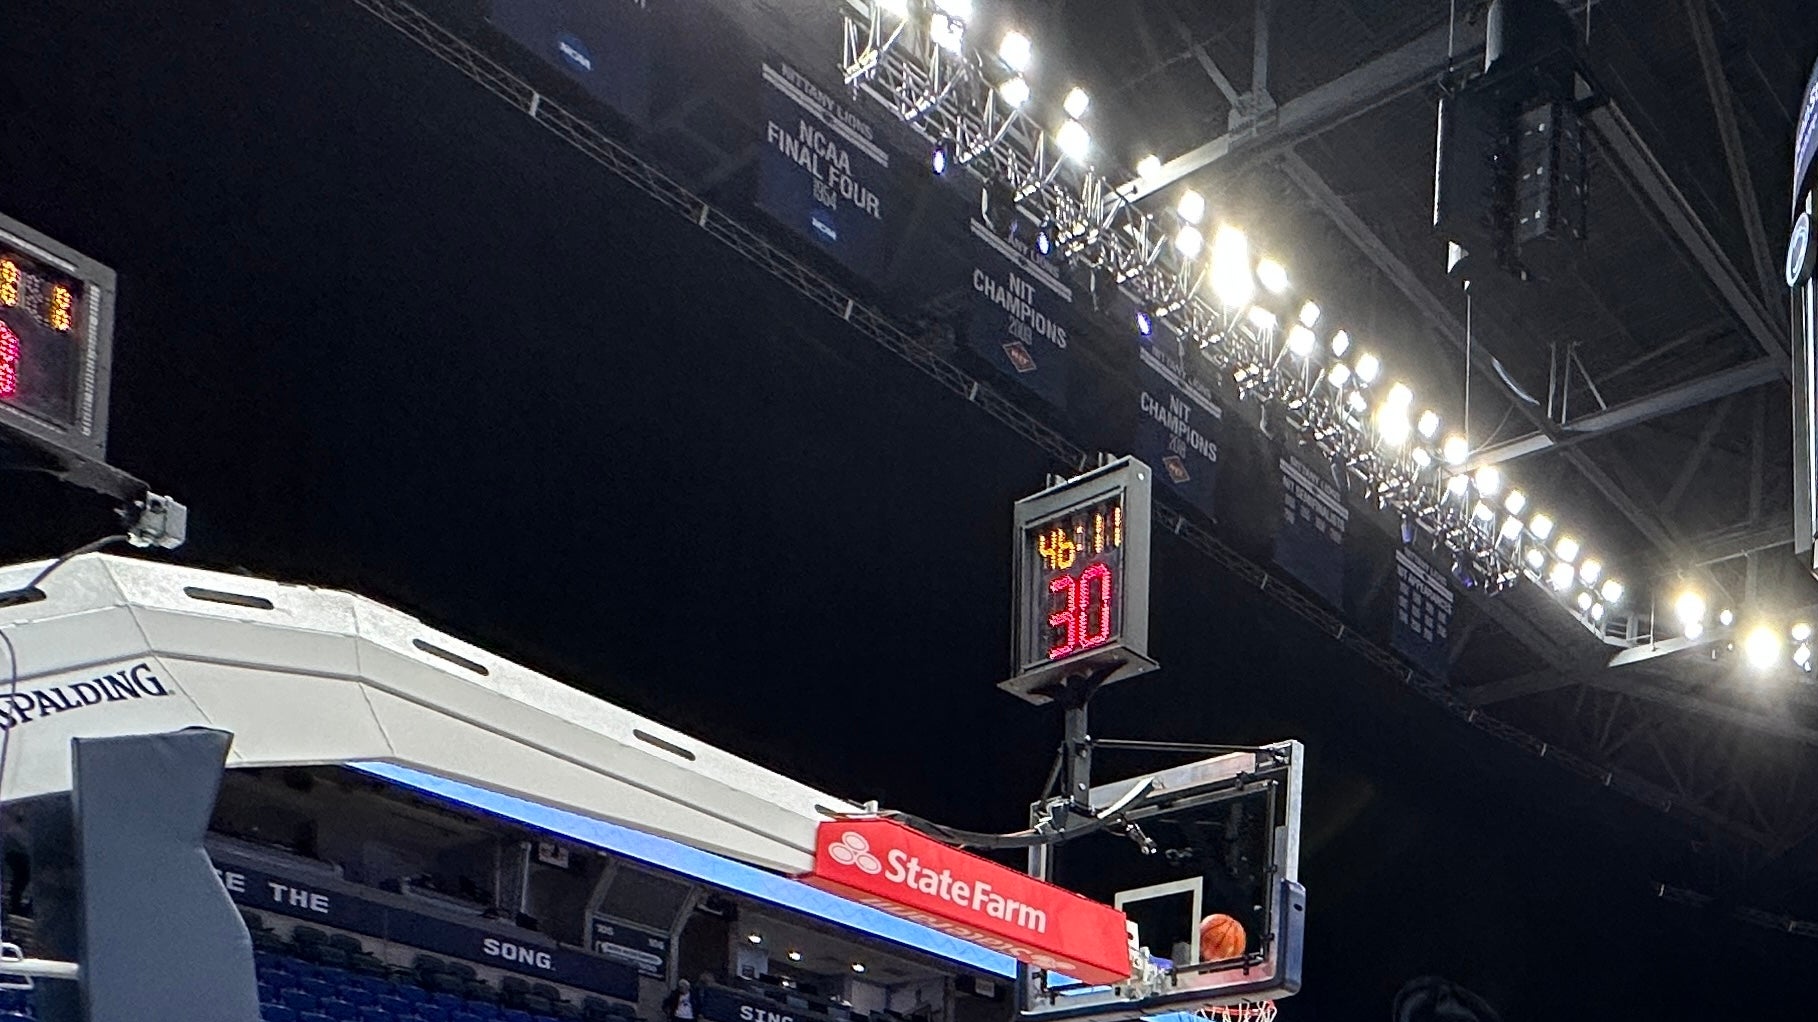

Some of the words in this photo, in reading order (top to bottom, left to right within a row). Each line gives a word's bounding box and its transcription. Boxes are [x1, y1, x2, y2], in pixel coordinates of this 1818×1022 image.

[767, 120, 824, 181] FINAL
[828, 165, 882, 220] FOUR
[799, 119, 852, 176] NCAA
[972, 266, 1069, 350] CHAMPIONS
[1008, 271, 1037, 307] NIT
[1140, 390, 1219, 464] CHAMPIONS
[1169, 394, 1192, 424] NIT
[1038, 506, 1122, 571] 46:11
[1048, 562, 1112, 660] 30
[267, 881, 330, 915] THE
[483, 938, 553, 971] SONG
[883, 846, 1048, 936] StateFarm
